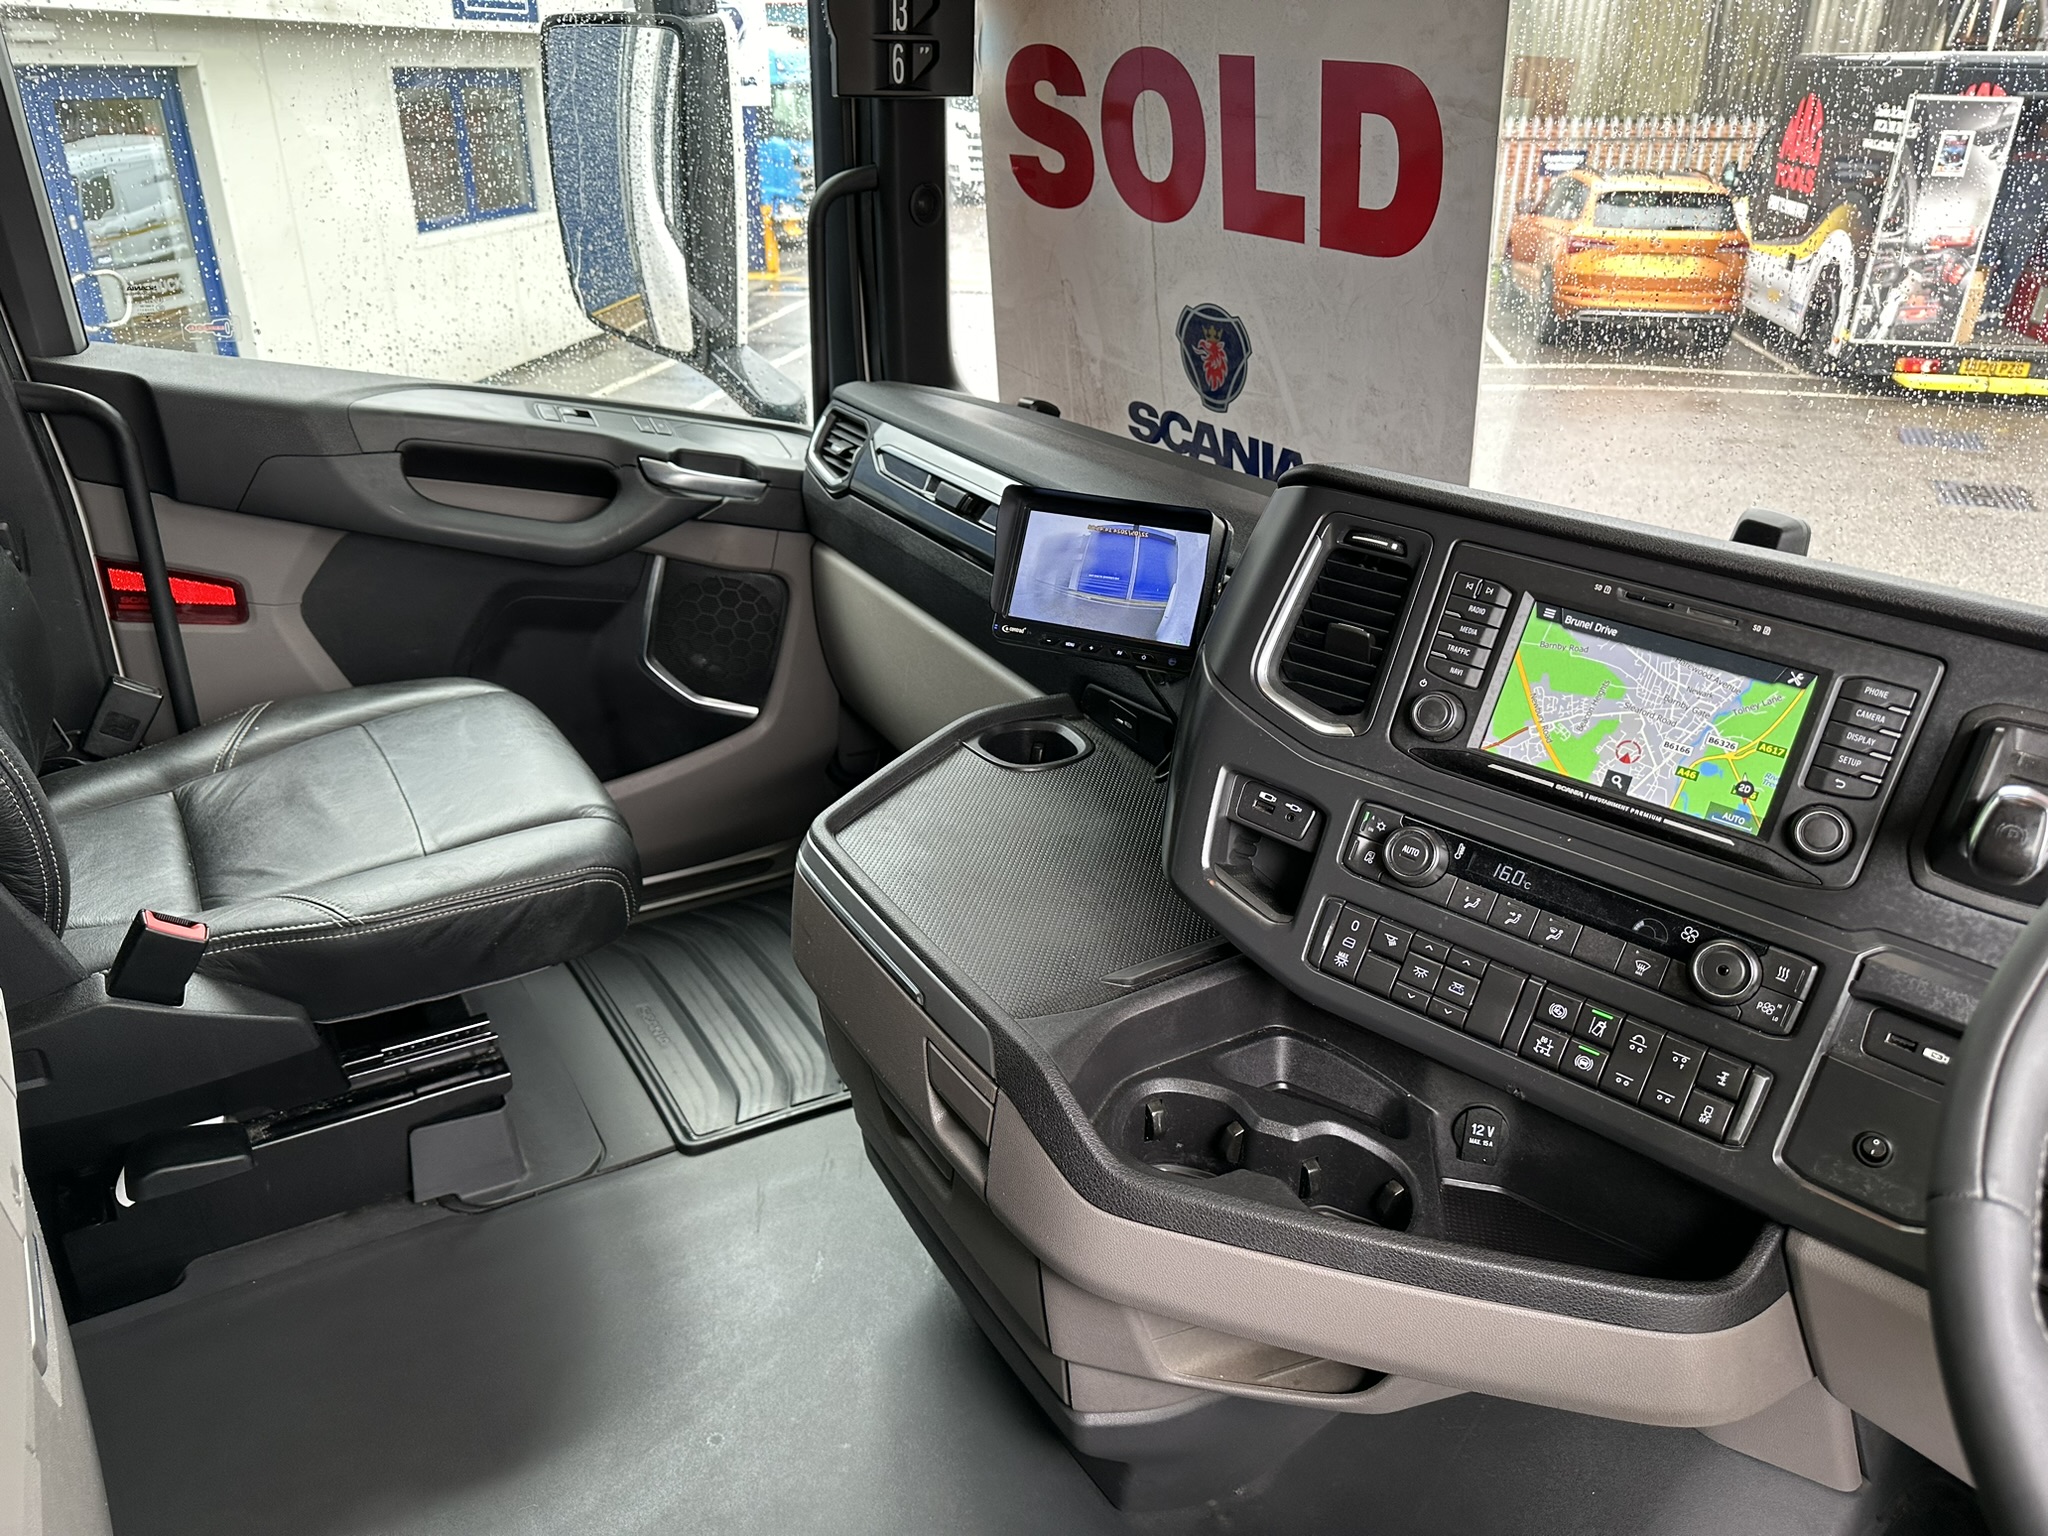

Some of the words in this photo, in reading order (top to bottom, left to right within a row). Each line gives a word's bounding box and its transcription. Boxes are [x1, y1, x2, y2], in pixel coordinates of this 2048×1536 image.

[892, 0, 908, 31] 13
[1005, 43, 1444, 258] SOLD
[1775, 161, 1816, 194] TOOLS
[1468, 605, 1486, 615] RADIO
[1459, 625, 1478, 636] MEDIA
[1564, 615, 1593, 630] Brunel
[1594, 622, 1618, 636] Drive
[1447, 643, 1471, 657] TRAFFIC
[1539, 640, 1567, 651] Barnby
[1569, 644, 1589, 653] Road
[1449, 666, 1464, 676] NAVI
[1675, 657, 1713, 680] Harewood
[1713, 676, 1742, 695] Avenue
[1686, 686, 1714, 699] Newark
[1864, 686, 1890, 699] PHONE
[1576, 706, 1594, 732] Beacon
[1592, 679, 1610, 706] Heights
[1663, 694, 1690, 711] Barnby
[1691, 706, 1711, 719] Gate
[1732, 702, 1761, 717] Tolney
[1762, 694, 1783, 707] Lane
[1623, 702, 1658, 721] Sleaford
[1656, 714, 1678, 728] Road
[1855, 709, 1886, 723] CAMERA
[1708, 736, 1736, 750] B6326
[1846, 731, 1876, 746] DISPLAY
[1663, 741, 1691, 754] B6166
[1758, 743, 1786, 756] A617
[1838, 755, 1862, 767] SETUP
[1677, 769, 1697, 779] A46
[1738, 783, 1751, 793] 2D
[1555, 784, 1584, 798] SCANIA
[1629, 808, 1662, 823] PREMIUM
[1721, 812, 1746, 824] AUTO
[1402, 844, 1420, 857] AUTO
[1698, 1115, 1710, 1125] OFF
[1471, 1123, 1485, 1137] 12
[1487, 1125, 1495, 1138] V
